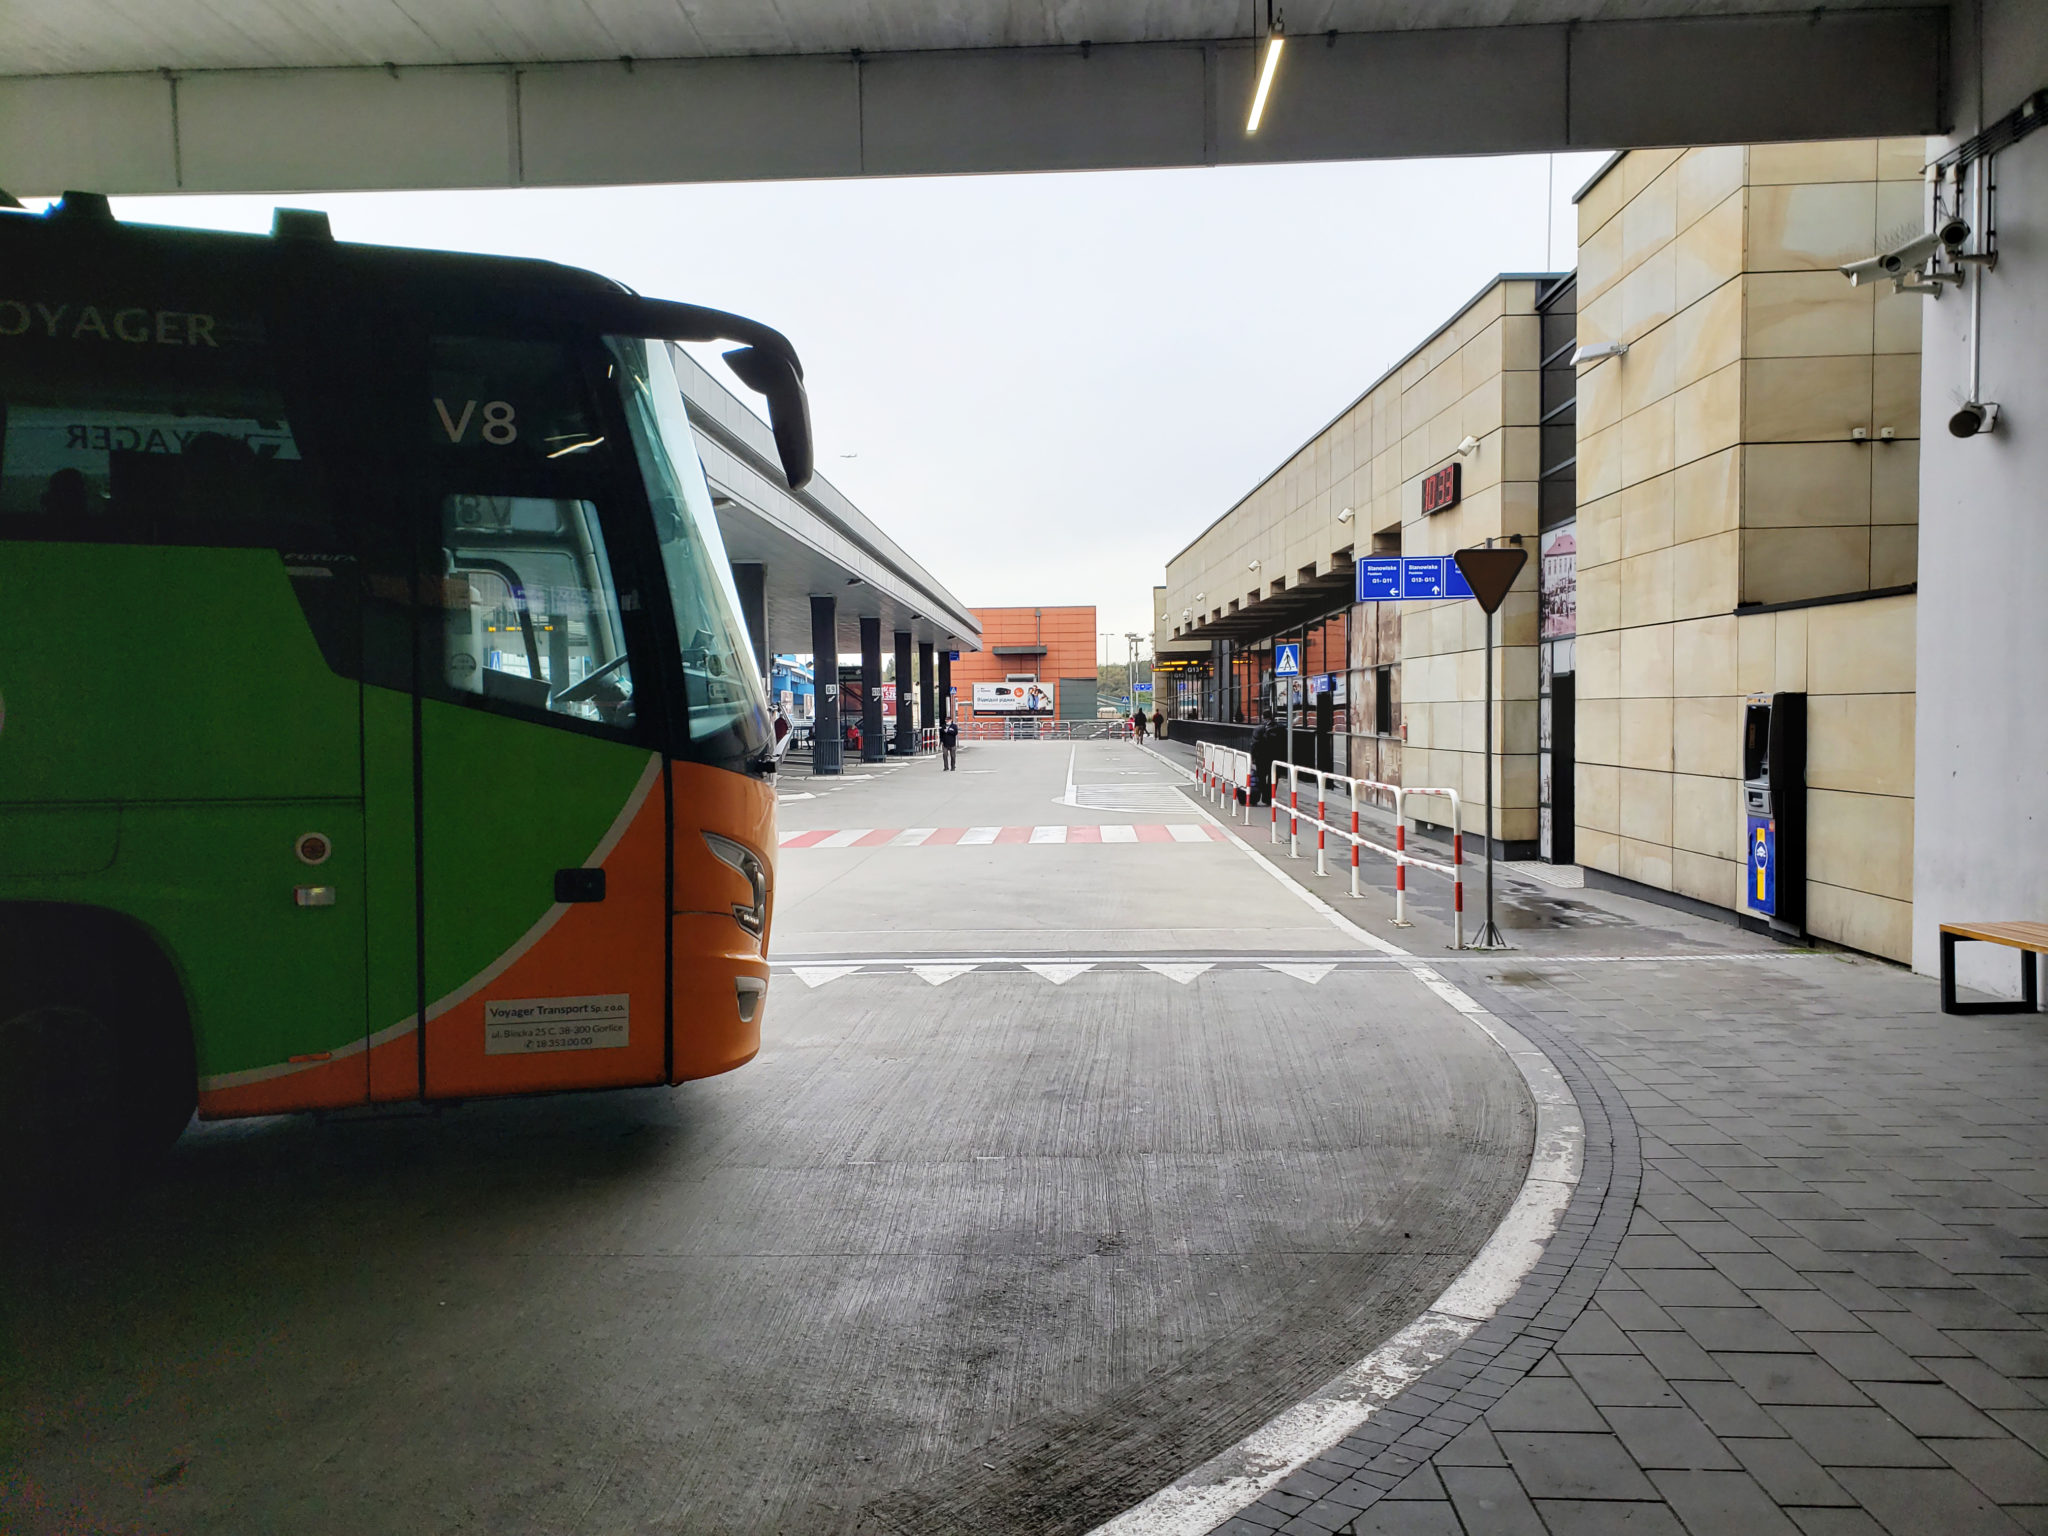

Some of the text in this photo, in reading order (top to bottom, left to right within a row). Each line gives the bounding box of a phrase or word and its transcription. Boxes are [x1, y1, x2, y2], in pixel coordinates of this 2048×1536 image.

[433, 397, 518, 445] V8
[826, 686, 836, 694] G9
[489, 1007, 535, 1019] Voyager
[537, 1004, 589, 1017] Transport
[592, 1023, 623, 1033] Gorlice
